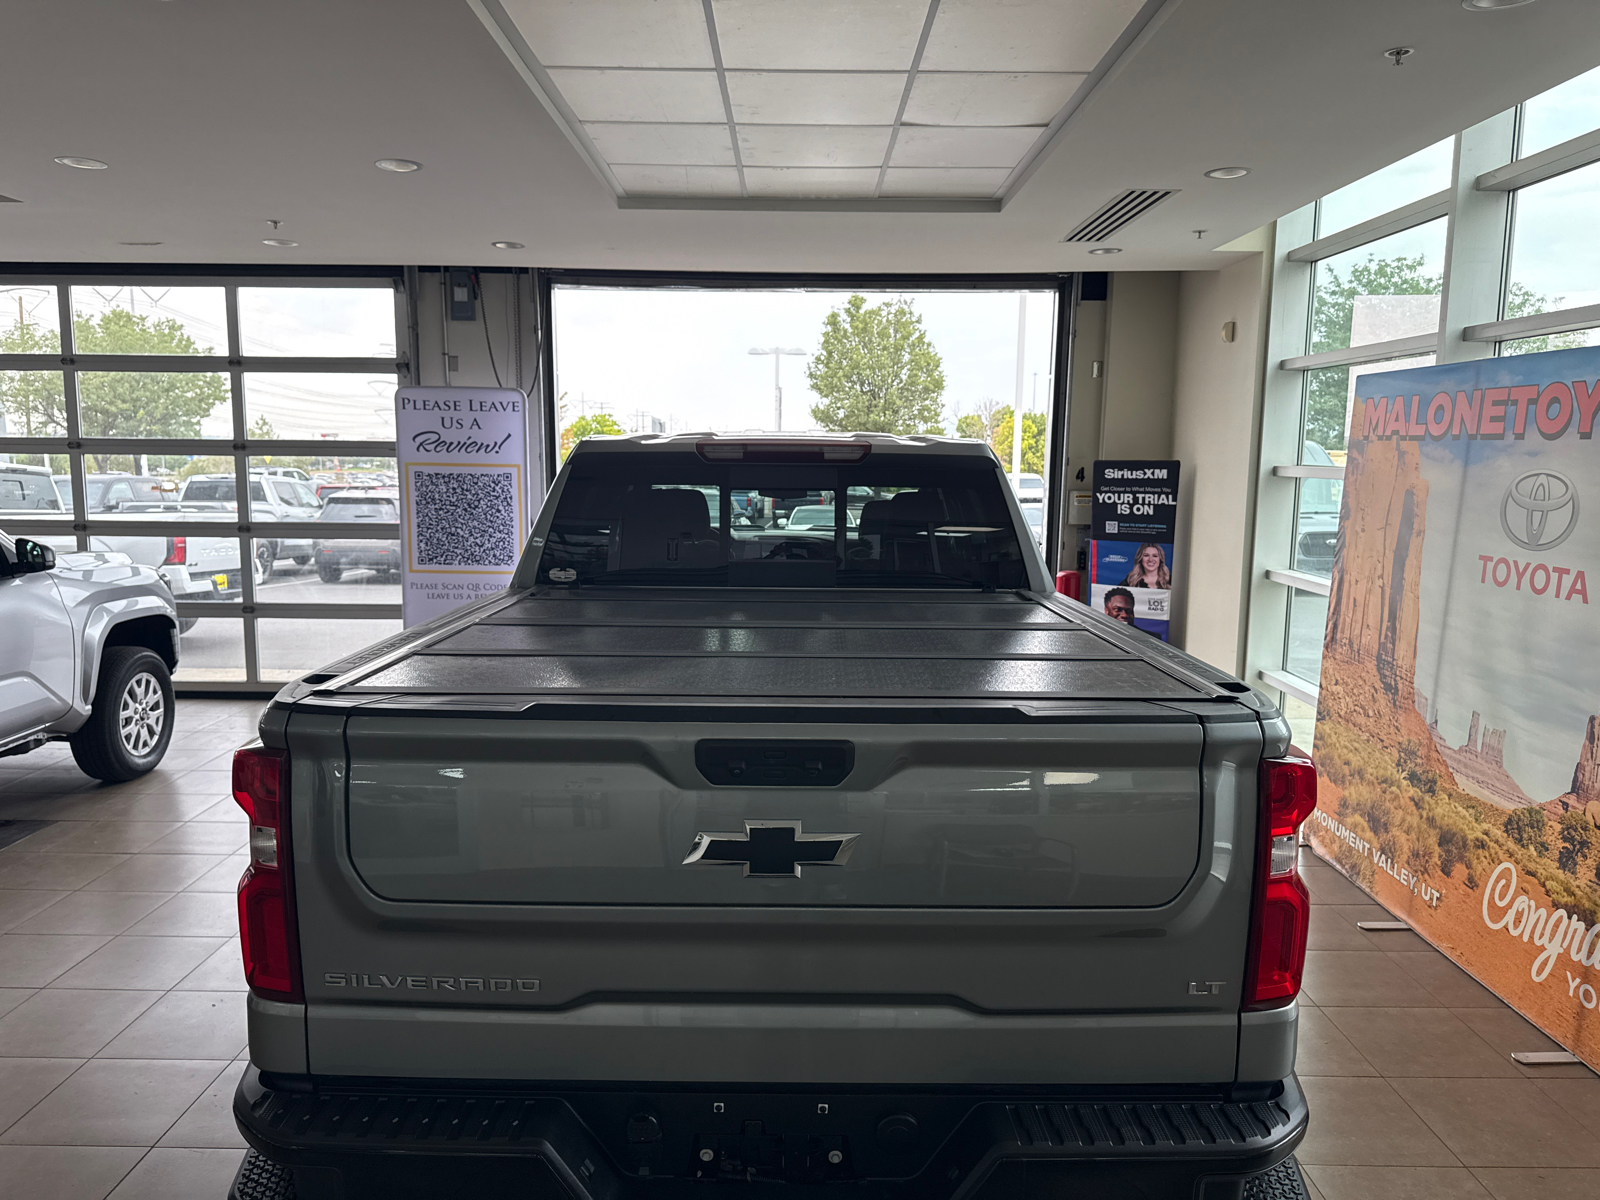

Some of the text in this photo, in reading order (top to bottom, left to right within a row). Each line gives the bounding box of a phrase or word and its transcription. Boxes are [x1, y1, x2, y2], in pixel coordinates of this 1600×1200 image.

[401, 396, 520, 413] PLEASE LEAVE
[441, 416, 483, 430] US A
[412, 430, 512, 454] Review!
[1076, 467, 1085, 482] 4
[1104, 468, 1167, 479] SiriusXM
[1096, 492, 1134, 504] YOUR
[1136, 493, 1177, 505] TRIAL
[1117, 504, 1154, 516] IS ON
[1478, 554, 1589, 605] TOYOTA
[410, 582, 439, 591] PLEASE
[441, 582, 464, 592] SCAN
[467, 582, 481, 593] QR
[427, 592, 450, 600] LEAVE
[1313, 806, 1440, 907] MONUMENT VALLEY, UT
[324, 972, 541, 992] SILVERADO
[1188, 981, 1227, 995] LT
[1566, 970, 1600, 1009] YO
